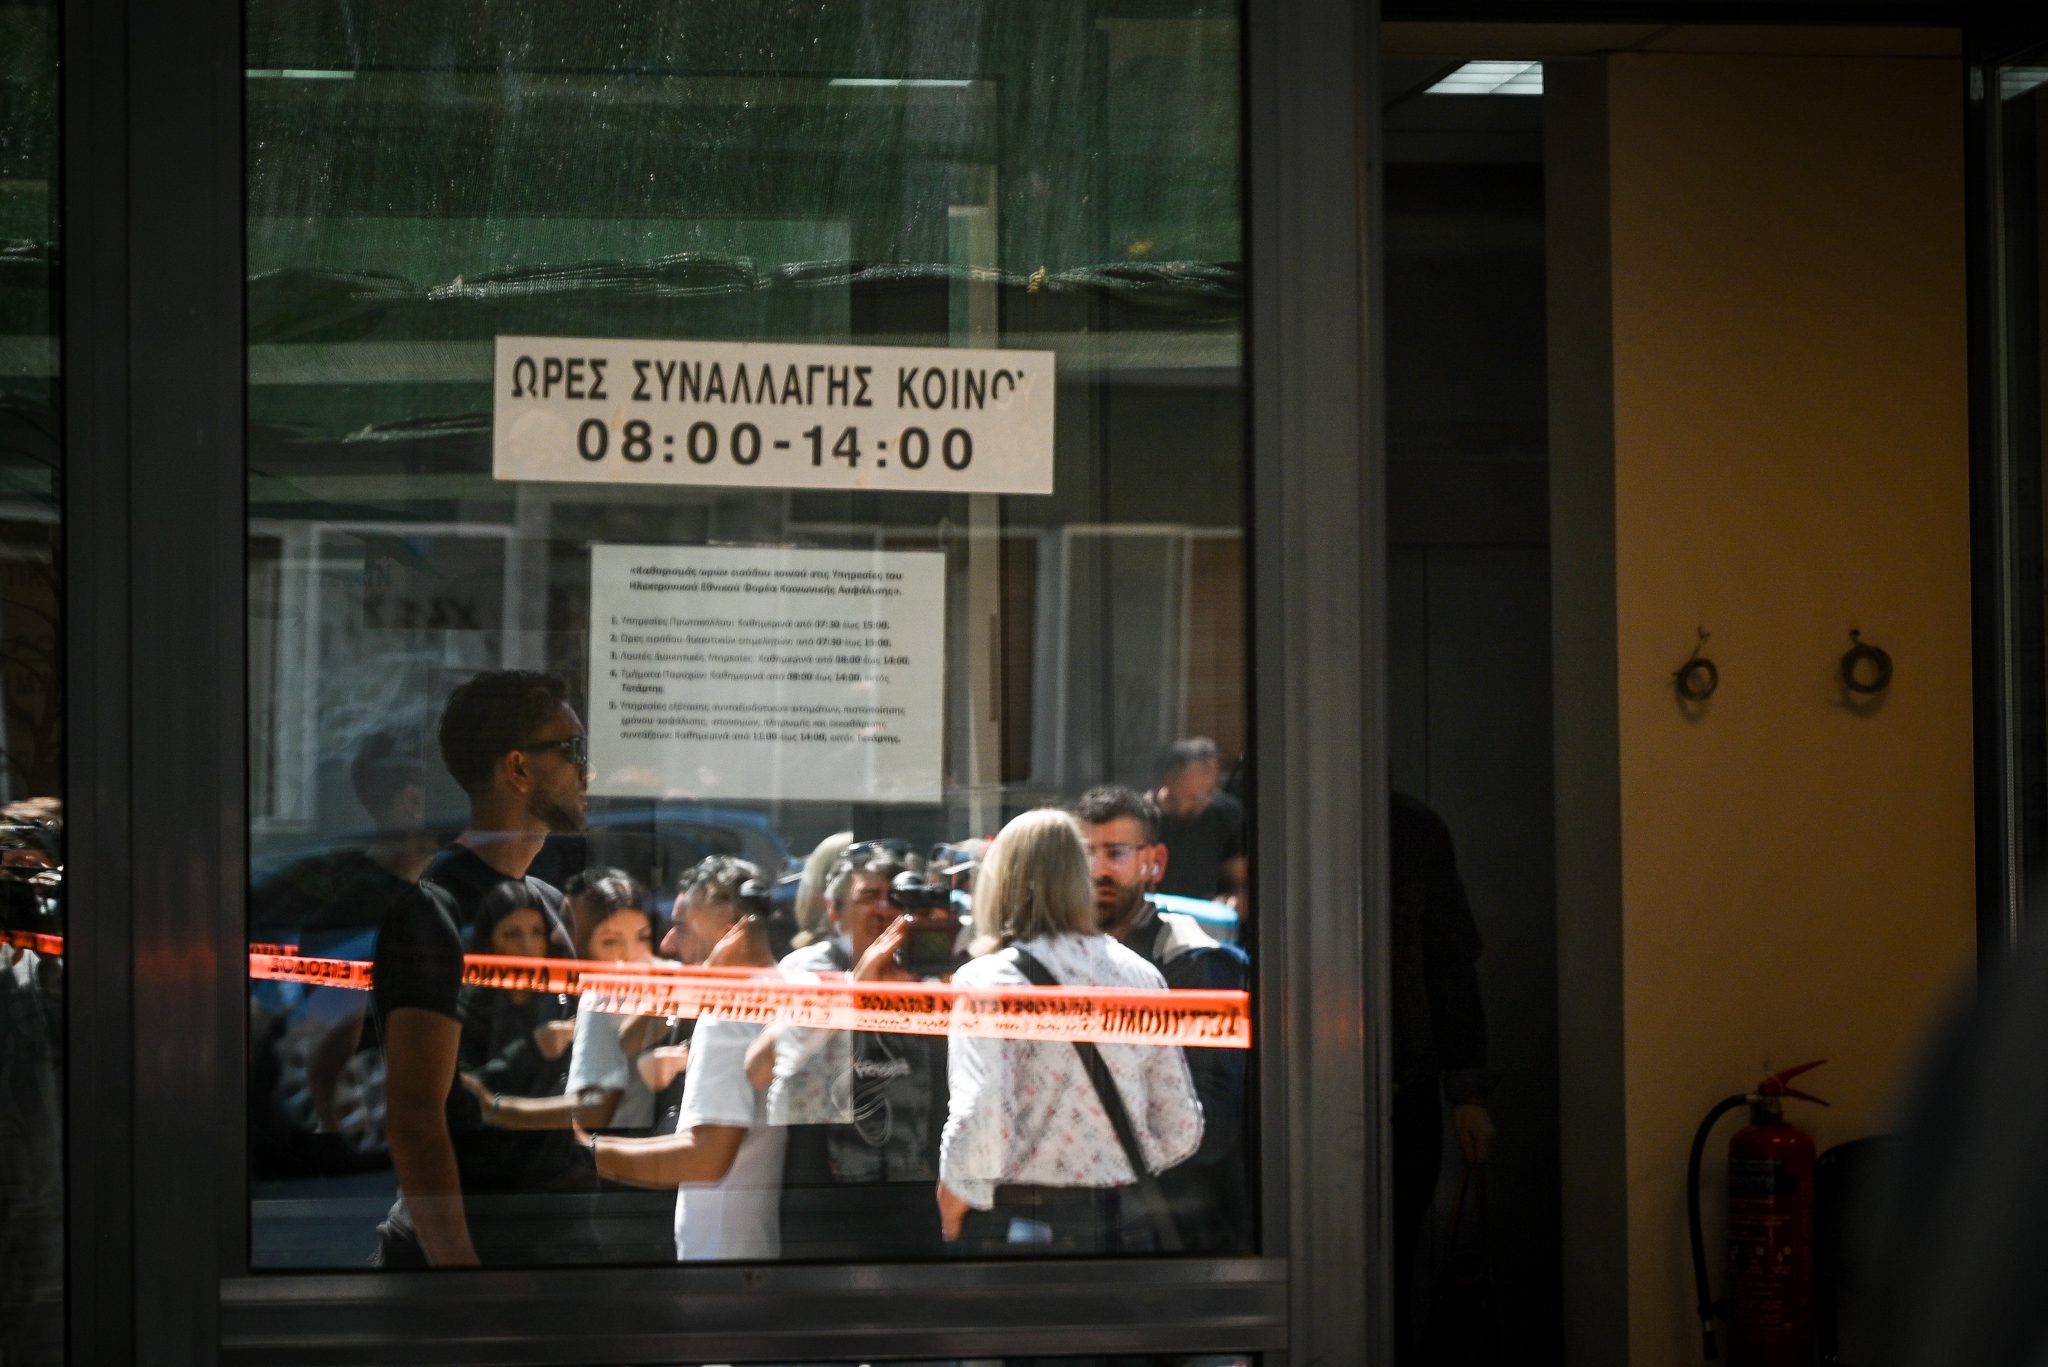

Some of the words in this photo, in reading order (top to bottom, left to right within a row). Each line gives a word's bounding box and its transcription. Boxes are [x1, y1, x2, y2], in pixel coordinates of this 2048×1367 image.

[511, 355, 608, 401] ΩΡΕΣ
[631, 360, 873, 407] ΣΥΝΑΛΛΑΓΗΣ
[897, 367, 1029, 409] ΚΟΙΝΟ
[577, 419, 973, 471] 08:00-14:00
[774, 569, 807, 578] κοινού
[832, 569, 882, 581] Υπηρεσίες
[629, 581, 698, 592] Ηλεκτρονικού
[701, 582, 740, 592] Εθνικού
[780, 584, 835, 596] Κοινωνικής
[611, 617, 618, 625] 1.
[610, 634, 618, 643] 2.
